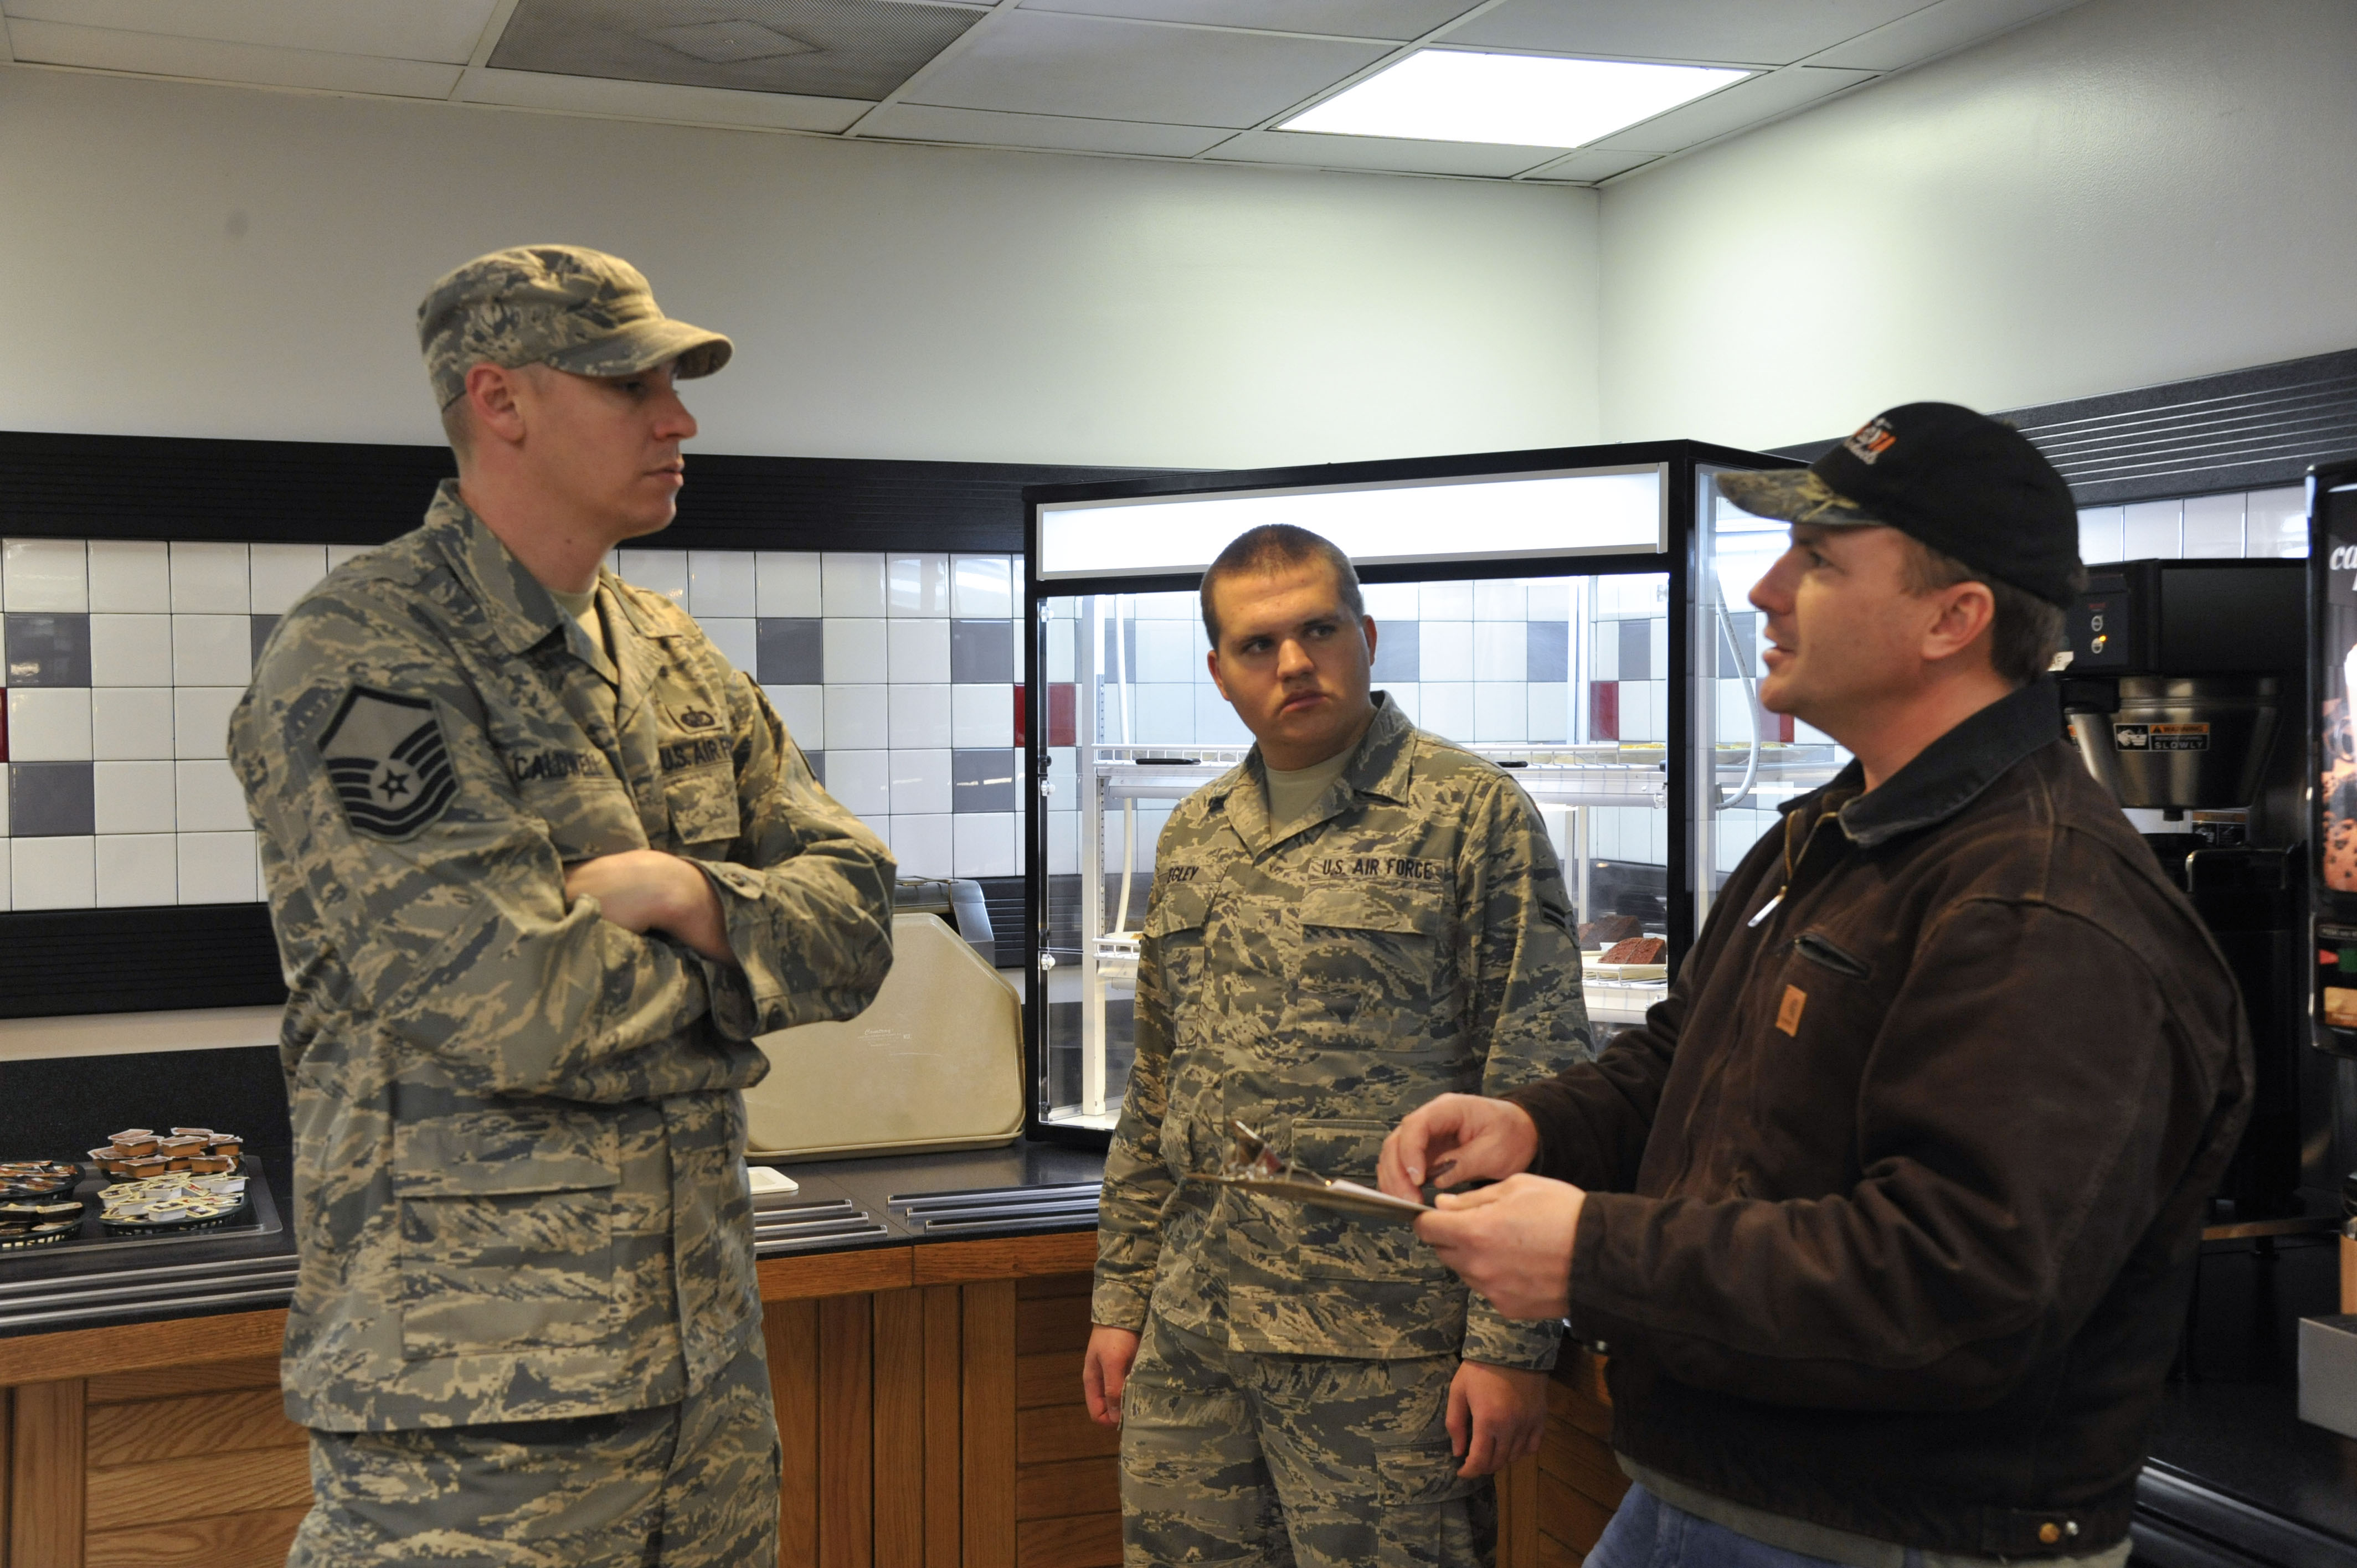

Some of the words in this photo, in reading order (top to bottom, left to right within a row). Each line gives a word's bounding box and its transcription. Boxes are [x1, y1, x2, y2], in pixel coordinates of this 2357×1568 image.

[694, 739, 722, 765] AIR
[1352, 858, 1380, 875] AIR
[1387, 858, 1433, 880] FORCE
